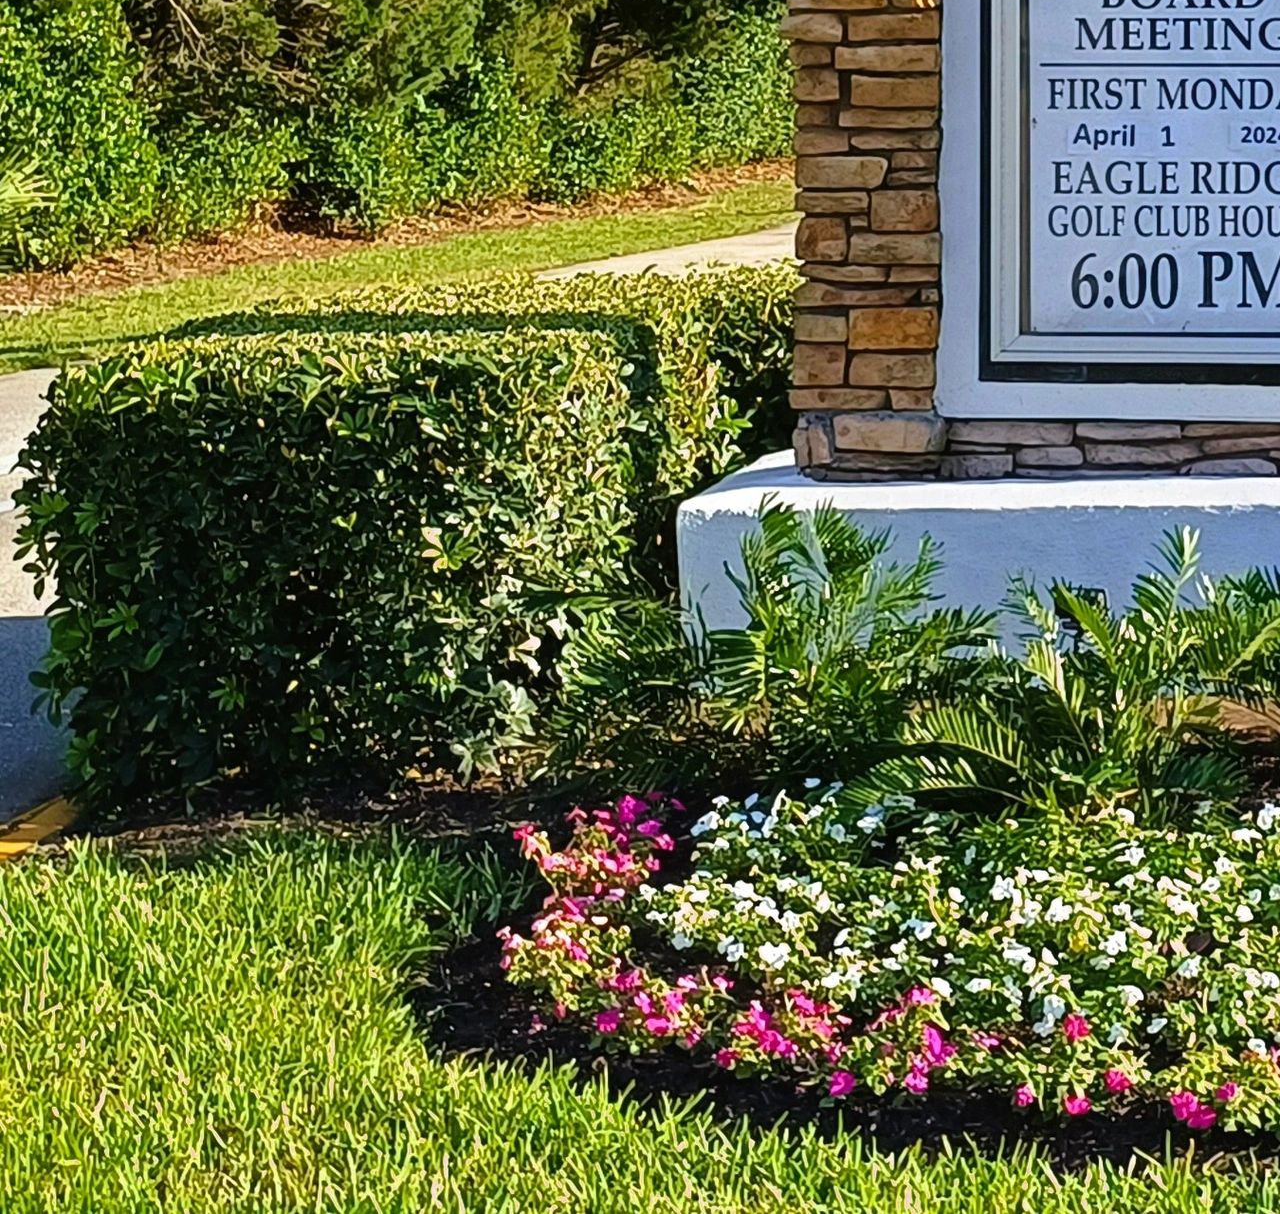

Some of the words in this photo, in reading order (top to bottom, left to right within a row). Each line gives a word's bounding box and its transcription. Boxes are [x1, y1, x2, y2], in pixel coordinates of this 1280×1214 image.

[1047, 78, 1146, 110] FIRST
[1073, 123, 1136, 150] April
[1161, 127, 1175, 147] 1
[1052, 161, 1179, 194] EAGLE
[1048, 206, 1125, 237] GOLF
[1134, 206, 1210, 237] CLUB
[1071, 252, 1178, 309] 6:00
